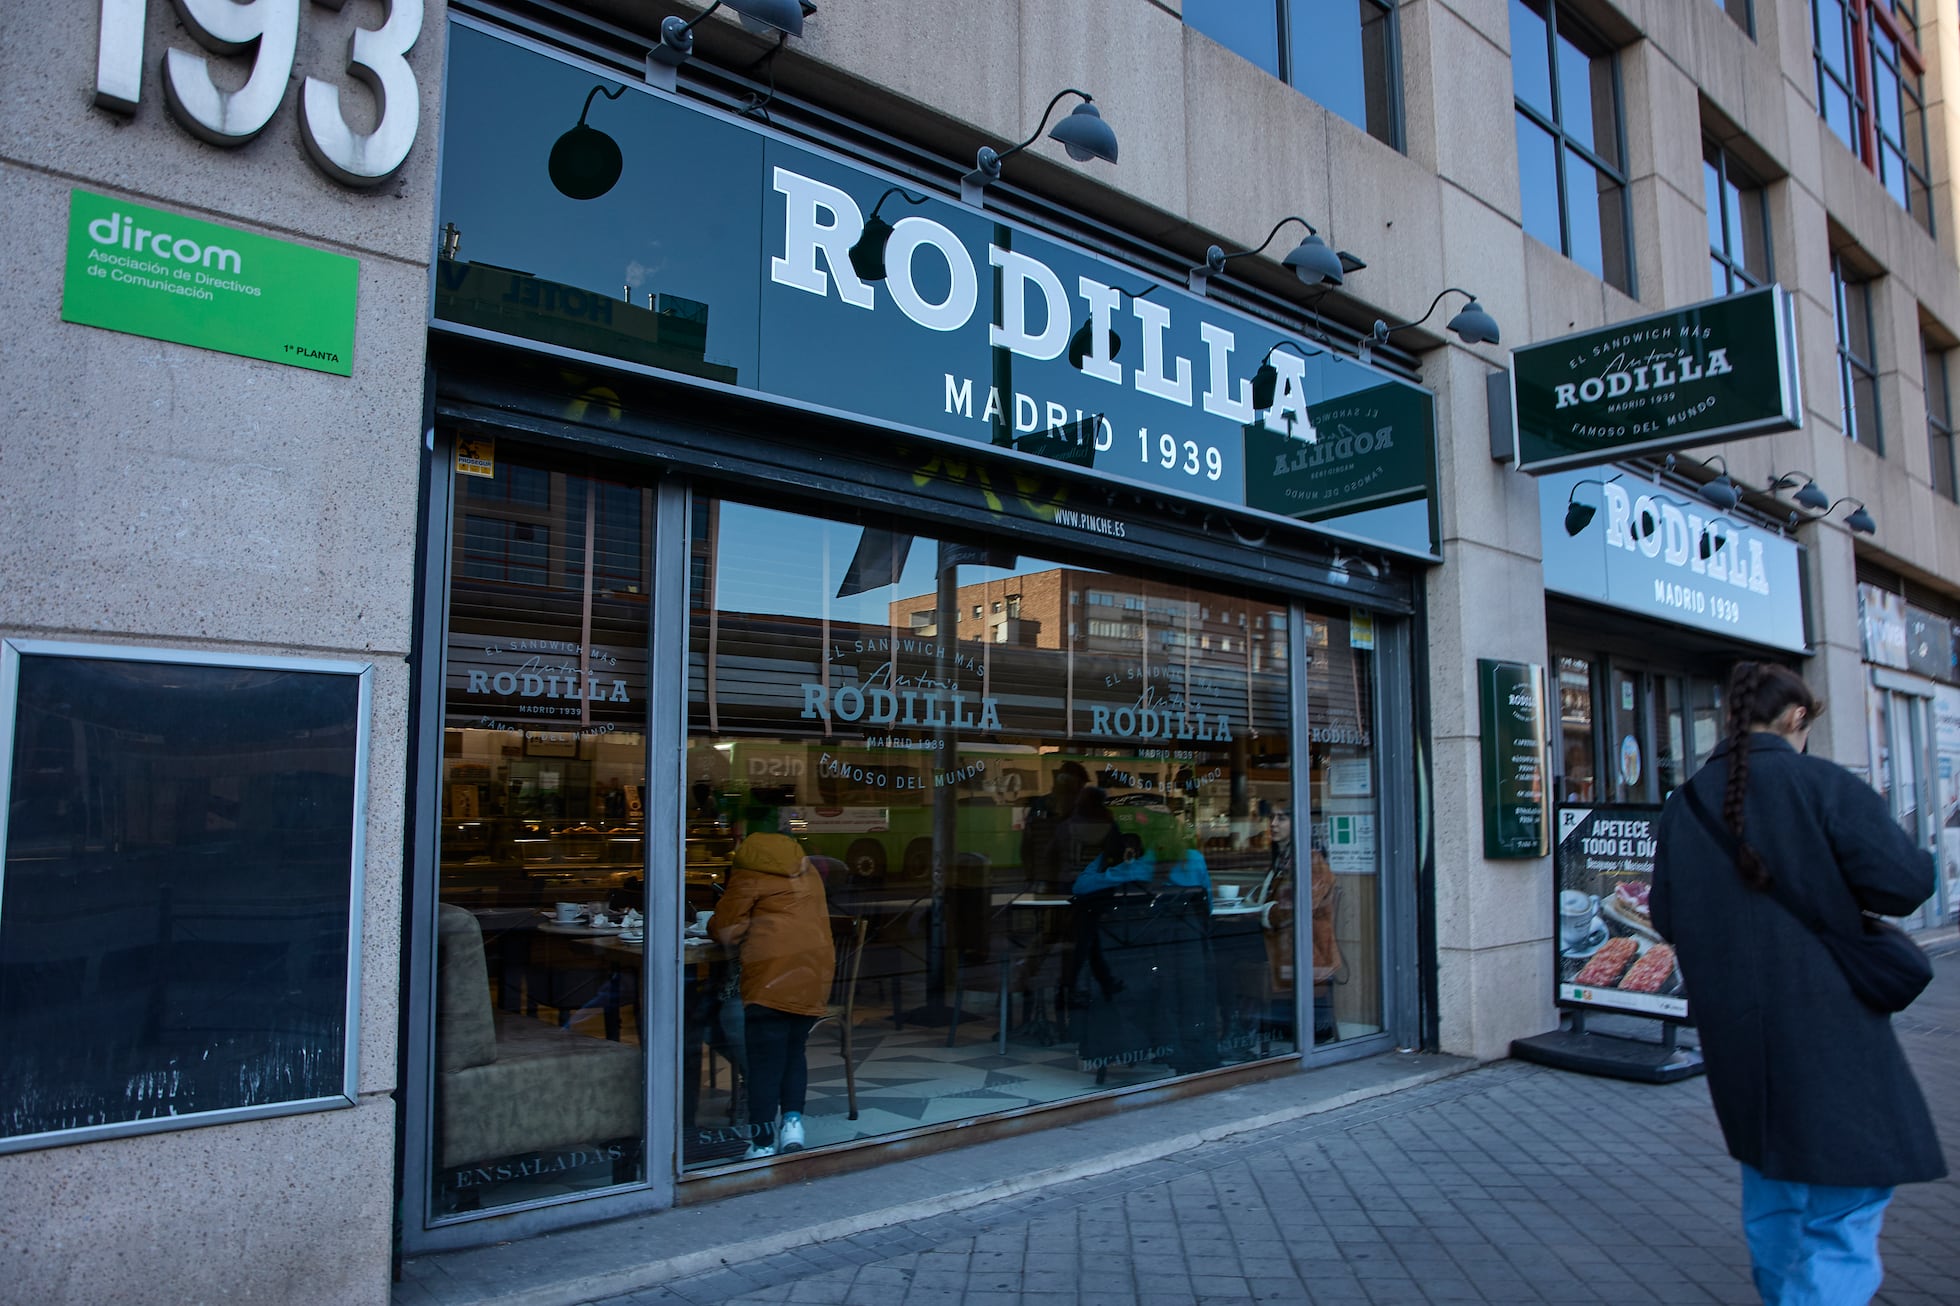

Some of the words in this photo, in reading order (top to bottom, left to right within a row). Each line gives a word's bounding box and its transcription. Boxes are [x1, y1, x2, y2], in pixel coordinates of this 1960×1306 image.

[96, 0, 424, 184] 193
[88, 212, 241, 274] dircom
[87, 264, 107, 279] de
[111, 267, 214, 301] Comunicación
[88, 248, 169, 278] Asociación
[173, 267, 191, 281] de
[195, 271, 262, 297] Directivos
[771, 165, 1317, 446] RODILLA
[296, 346, 340, 364] PLANTA
[1568, 355, 1587, 370] EL
[1592, 327, 1671, 356] SANDWICH
[1680, 324, 1712, 339] MÁS
[1554, 347, 1733, 410] RODILLA
[1571, 422, 1625, 438] FAMOSO
[1633, 422, 1660, 435] DEL
[1667, 395, 1716, 426] MUNDO
[1607, 399, 1646, 414] MADRID
[1651, 391, 1676, 405] 1939
[944, 373, 1113, 453] MADRID
[1138, 428, 1223, 482] 1939
[1054, 508, 1126, 538] WWW.PINCHE.ES
[1603, 481, 1769, 596] RODILLA
[1654, 579, 1706, 614] MADRID
[1710, 596, 1740, 624] 1939
[485, 646, 503, 657] EL
[510, 640, 583, 654] SANDWICH
[590, 650, 617, 666] MÁS
[826, 645, 845, 662] EL
[855, 638, 945, 659] SANDWICH
[954, 651, 985, 677] MÁS
[466, 670, 630, 703] RODILLA
[1105, 675, 1121, 688] EL
[519, 705, 555, 715] MADRID
[559, 708, 582, 716] 1939
[800, 683, 1003, 730] RODILLA
[1090, 705, 1233, 742] RODILLA
[480, 714, 534, 740] FAMOSO
[541, 731, 565, 742] DEL
[573, 722, 615, 741] MUNDO
[867, 736, 912, 750] MADRID
[918, 738, 945, 750] 1939
[819, 751, 887, 787] FAMOSO
[896, 776, 926, 789] DEL
[934, 760, 985, 788] MUNDO
[1104, 763, 1153, 791] FAMOSO
[1185, 767, 1222, 791] MUNDO
[1581, 837, 1617, 856] TODO
[1618, 839, 1636, 857] EL
[1592, 819, 1650, 839] APETECE
[456, 1145, 626, 1190] ENSALADAS
